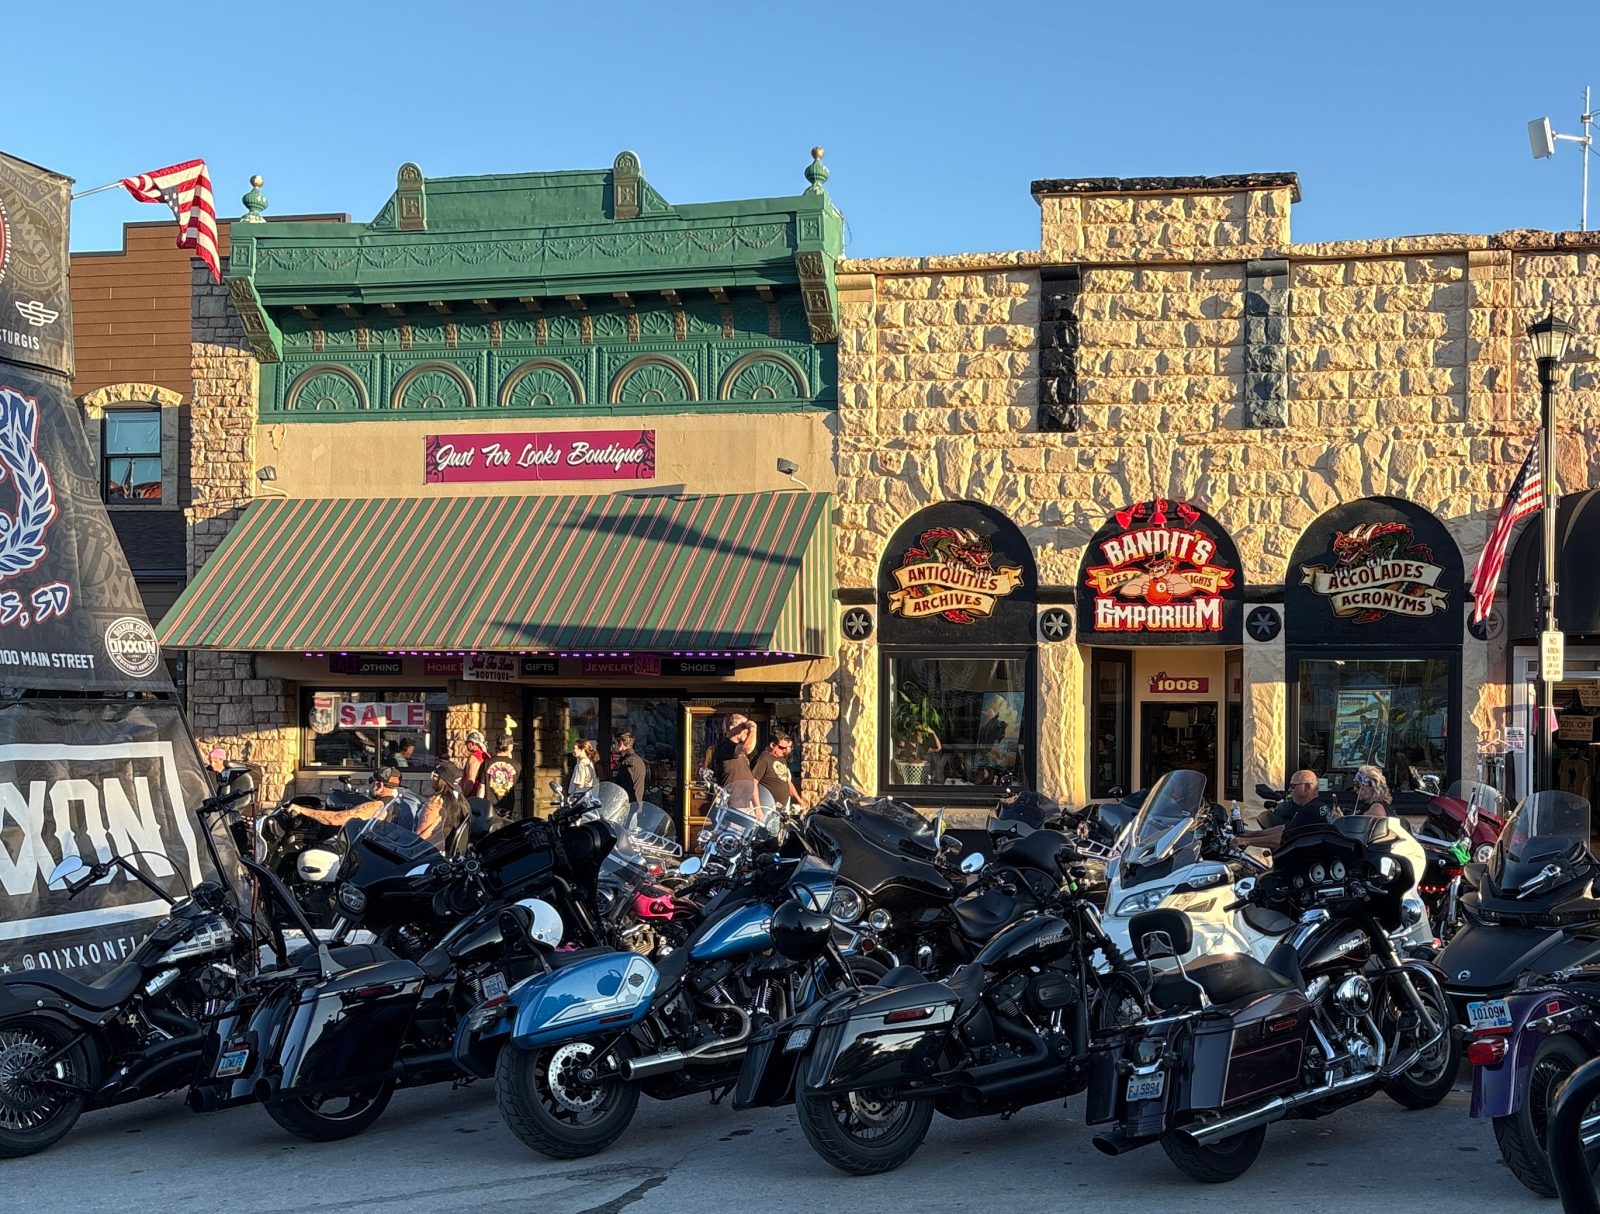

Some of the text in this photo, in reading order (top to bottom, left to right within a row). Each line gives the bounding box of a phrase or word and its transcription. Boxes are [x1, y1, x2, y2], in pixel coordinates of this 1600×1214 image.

[435, 441, 644, 472] Just For Looks Boutique
[1103, 529, 1214, 568] BANDIT'S
[908, 565, 998, 592] ANTIQUITIES
[1106, 573, 1130, 589] ACES
[1328, 563, 1425, 590] ACCOLADES
[31, 582, 71, 622] SD
[913, 593, 982, 613] ARCHIVES
[1341, 591, 1427, 612] ACRONYMS
[1096, 597, 1221, 630] EMPORIUM
[109, 639, 156, 654] DIXXON
[20, 651, 51, 667] MAIN
[51, 653, 95, 669] STREET
[427, 663, 457, 672] HOME
[525, 663, 555, 672] GIFTS
[585, 663, 635, 673] JEWELRY
[680, 662, 716, 673] SHOES
[1157, 679, 1200, 691] 1008
[340, 705, 424, 726] SALE
[1559, 720, 1593, 729] 50% OFF
